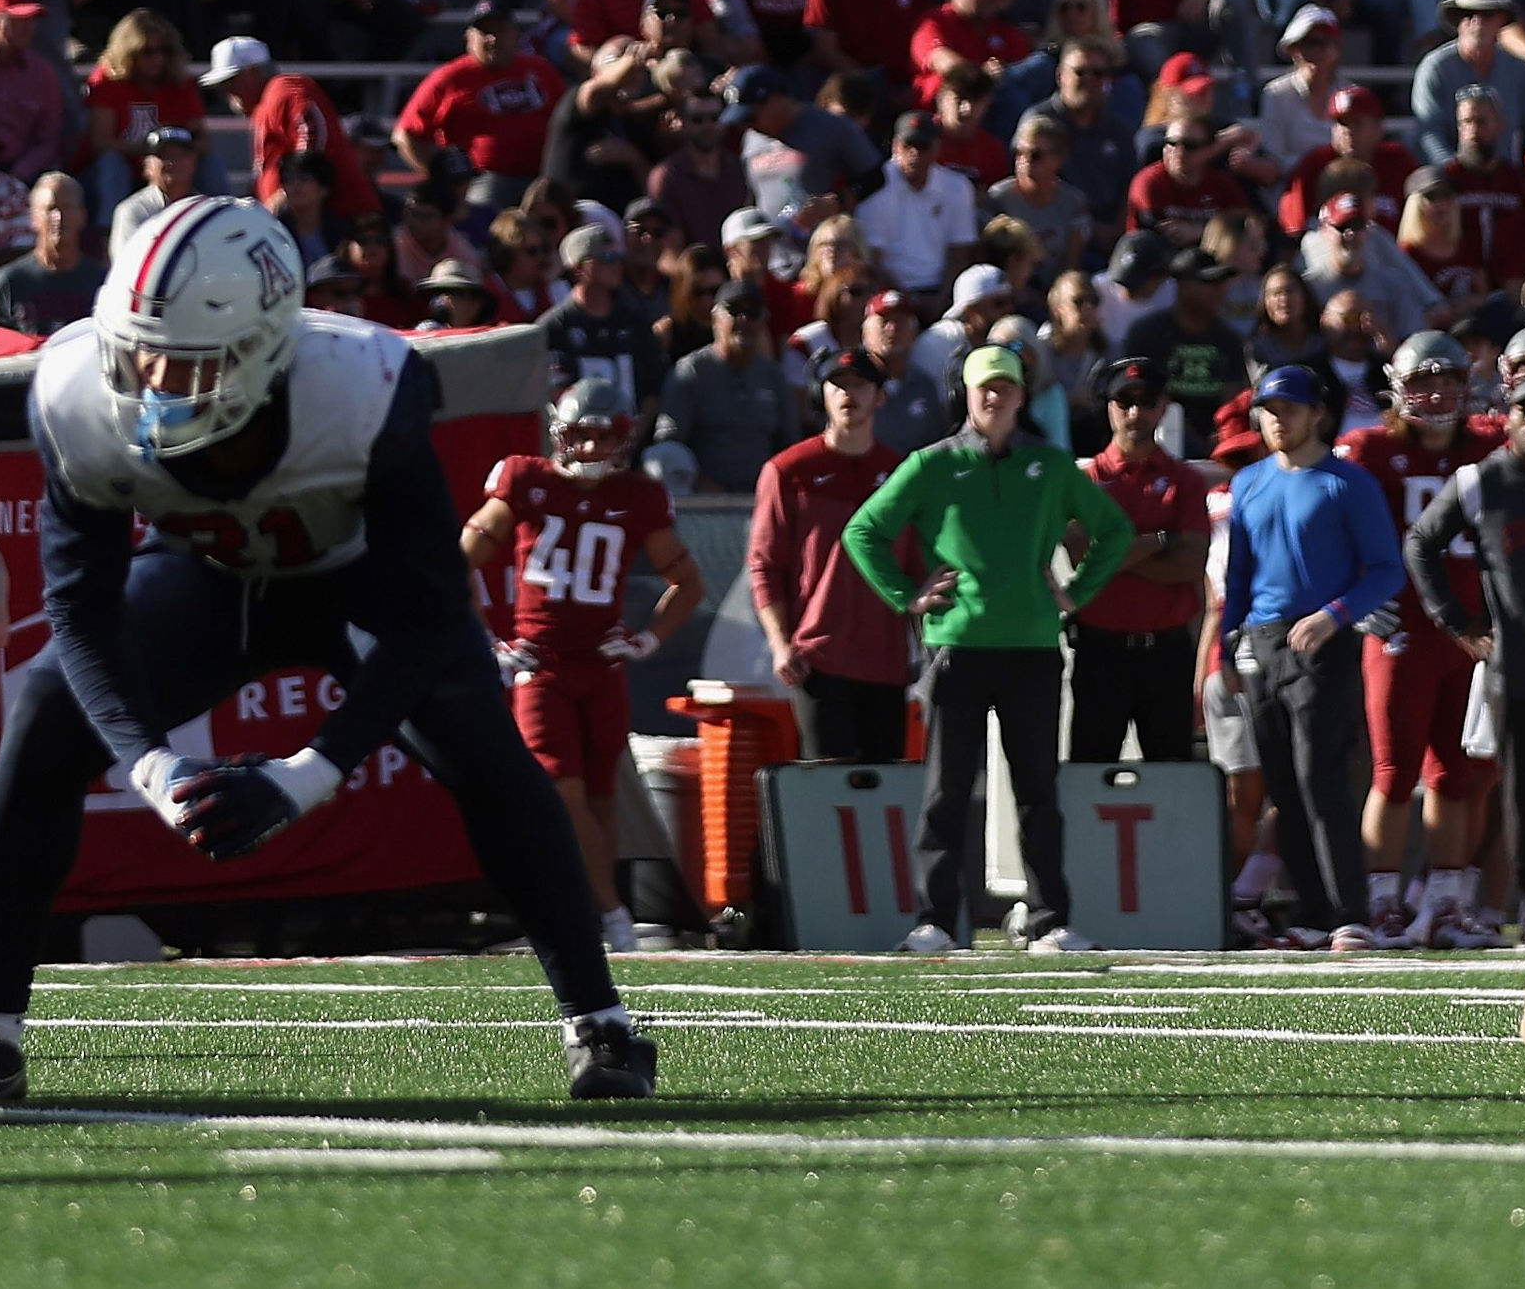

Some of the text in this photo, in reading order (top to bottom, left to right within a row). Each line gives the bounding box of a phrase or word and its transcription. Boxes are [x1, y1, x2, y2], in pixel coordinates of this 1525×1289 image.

[246, 237, 296, 311] A
[524, 513, 626, 605] 40
[1095, 803, 1155, 913] T
